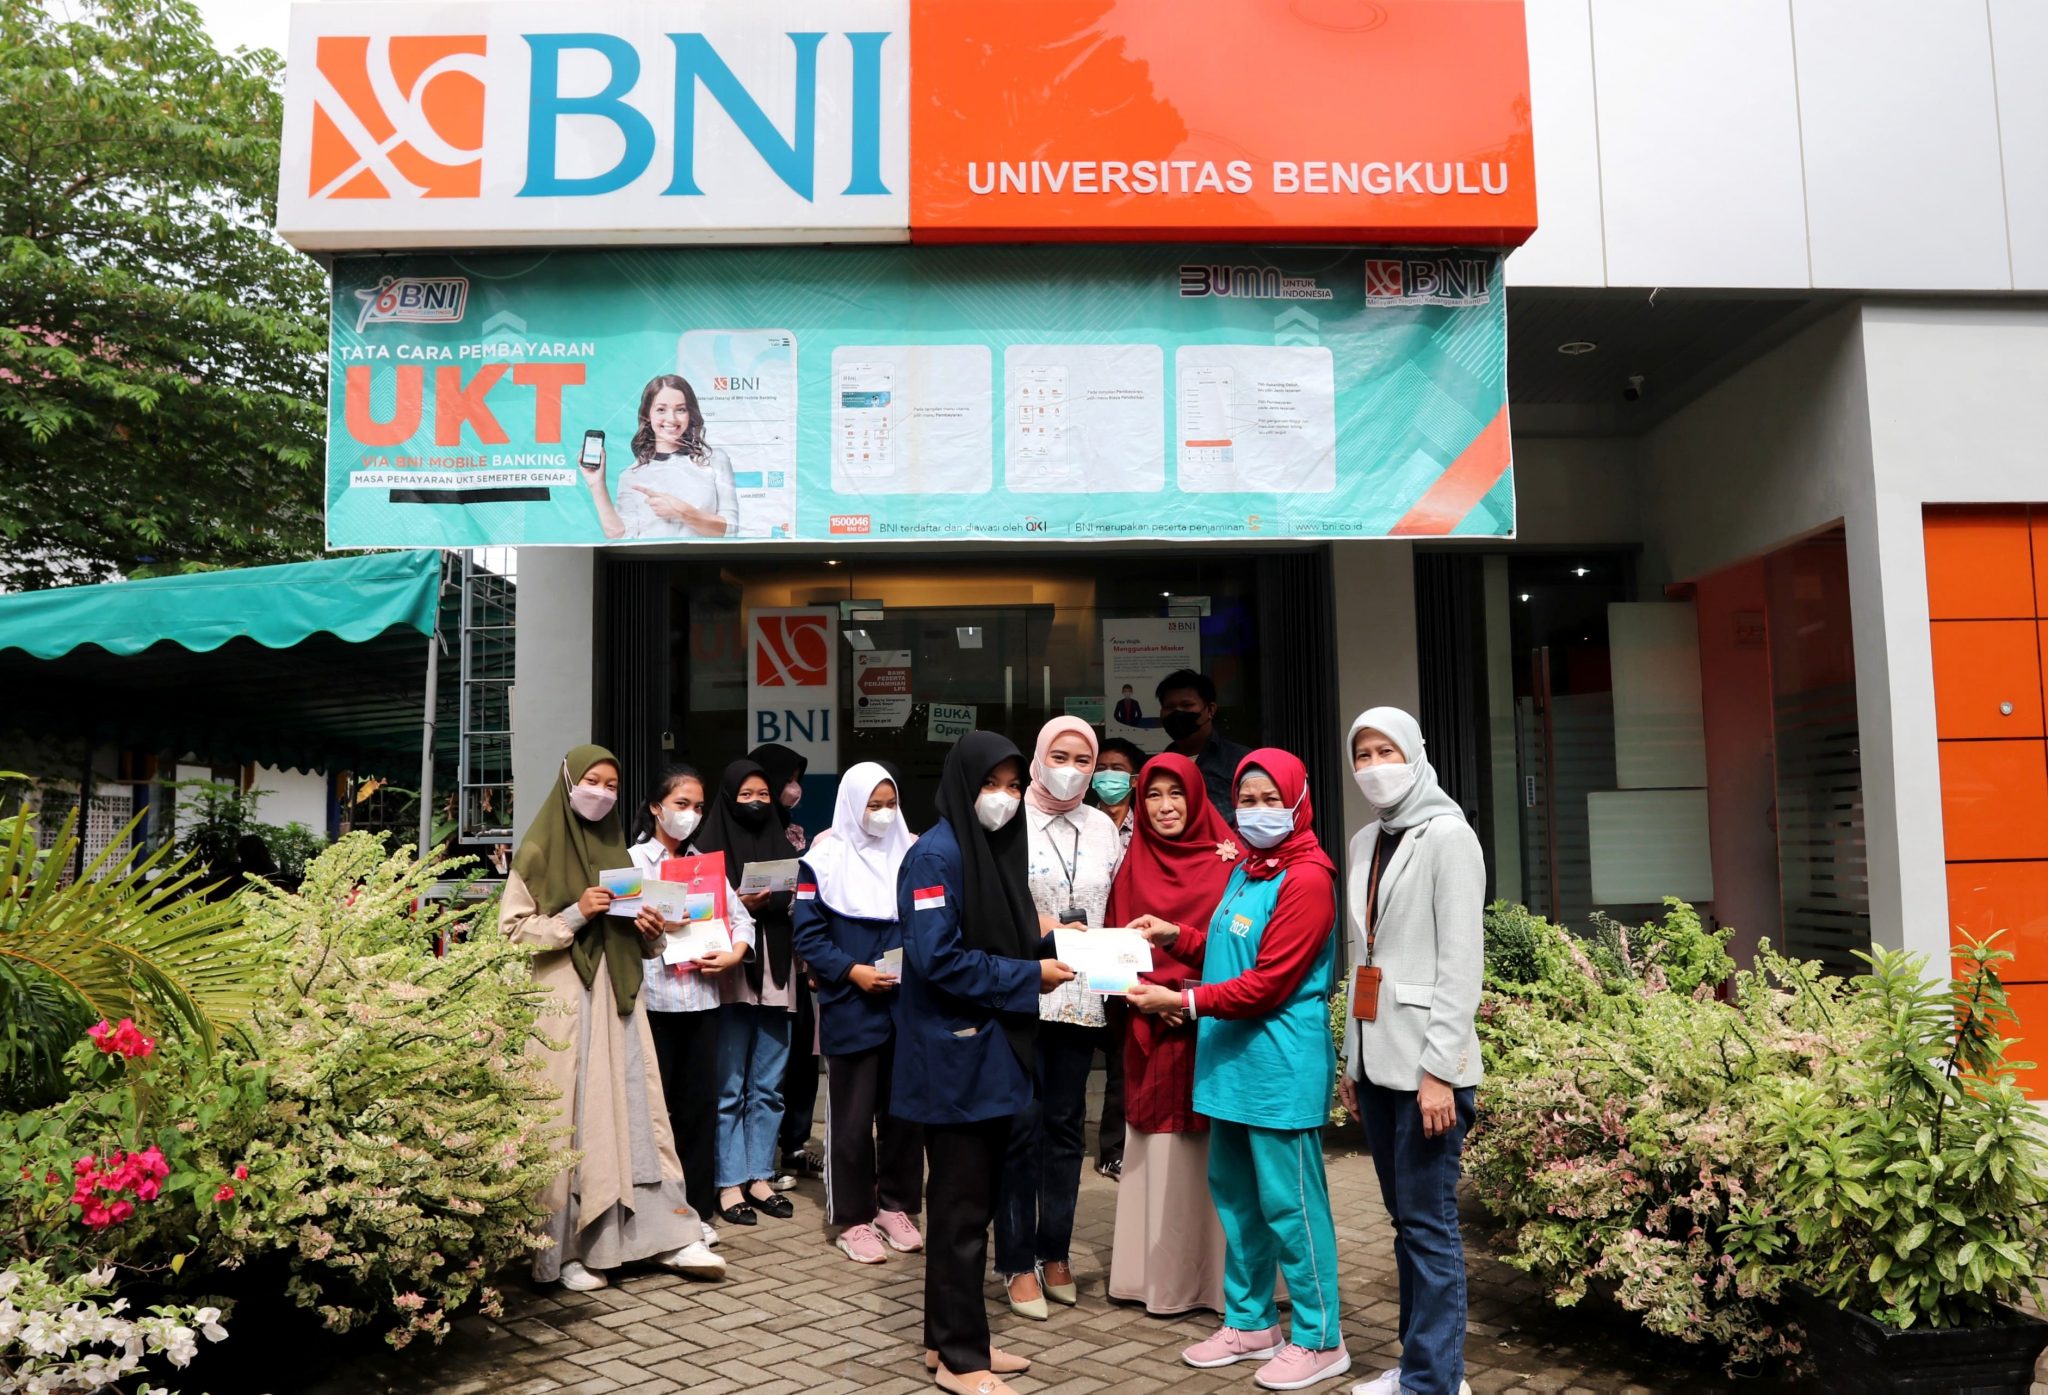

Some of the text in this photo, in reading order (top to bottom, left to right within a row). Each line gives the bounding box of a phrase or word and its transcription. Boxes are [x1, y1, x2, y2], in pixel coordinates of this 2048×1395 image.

[515, 32, 893, 204] BNI
[968, 160, 1509, 195] UNIVERSITAS BENGKULU
[1282, 280, 1314, 288] UNTUK
[1408, 259, 1489, 297] BNI
[399, 283, 458, 309] BNI
[1282, 290, 1332, 298] INDONESIA
[340, 342, 596, 361] TATA CARA PEMBAYARAN
[731, 377, 760, 390] BNI
[344, 362, 587, 447] UKT
[361, 454, 567, 469] VIA BNI MOBILE BANKING
[355, 475, 384, 483] MASA
[387, 475, 453, 484] PEMAYARAN
[456, 475, 474, 484] UKT
[476, 474, 528, 483] SEMERTER
[531, 473, 567, 482] GENAP
[831, 516, 869, 526] 1500046
[880, 523, 898, 532] BNI
[900, 522, 941, 532] terdaftar
[944, 523, 962, 532] dan
[965, 522, 1000, 532] diawasi
[1002, 522, 1023, 532] oleh
[1075, 522, 1245, 534] BNI merupakan peserta penjaminan
[1178, 622, 1196, 631] BNI
[1113, 645, 1159, 653] Menggunakan
[933, 707, 971, 720] BUKA
[756, 709, 831, 743] BNI
[935, 723, 969, 736] Open
[1229, 919, 1250, 938] 2022
